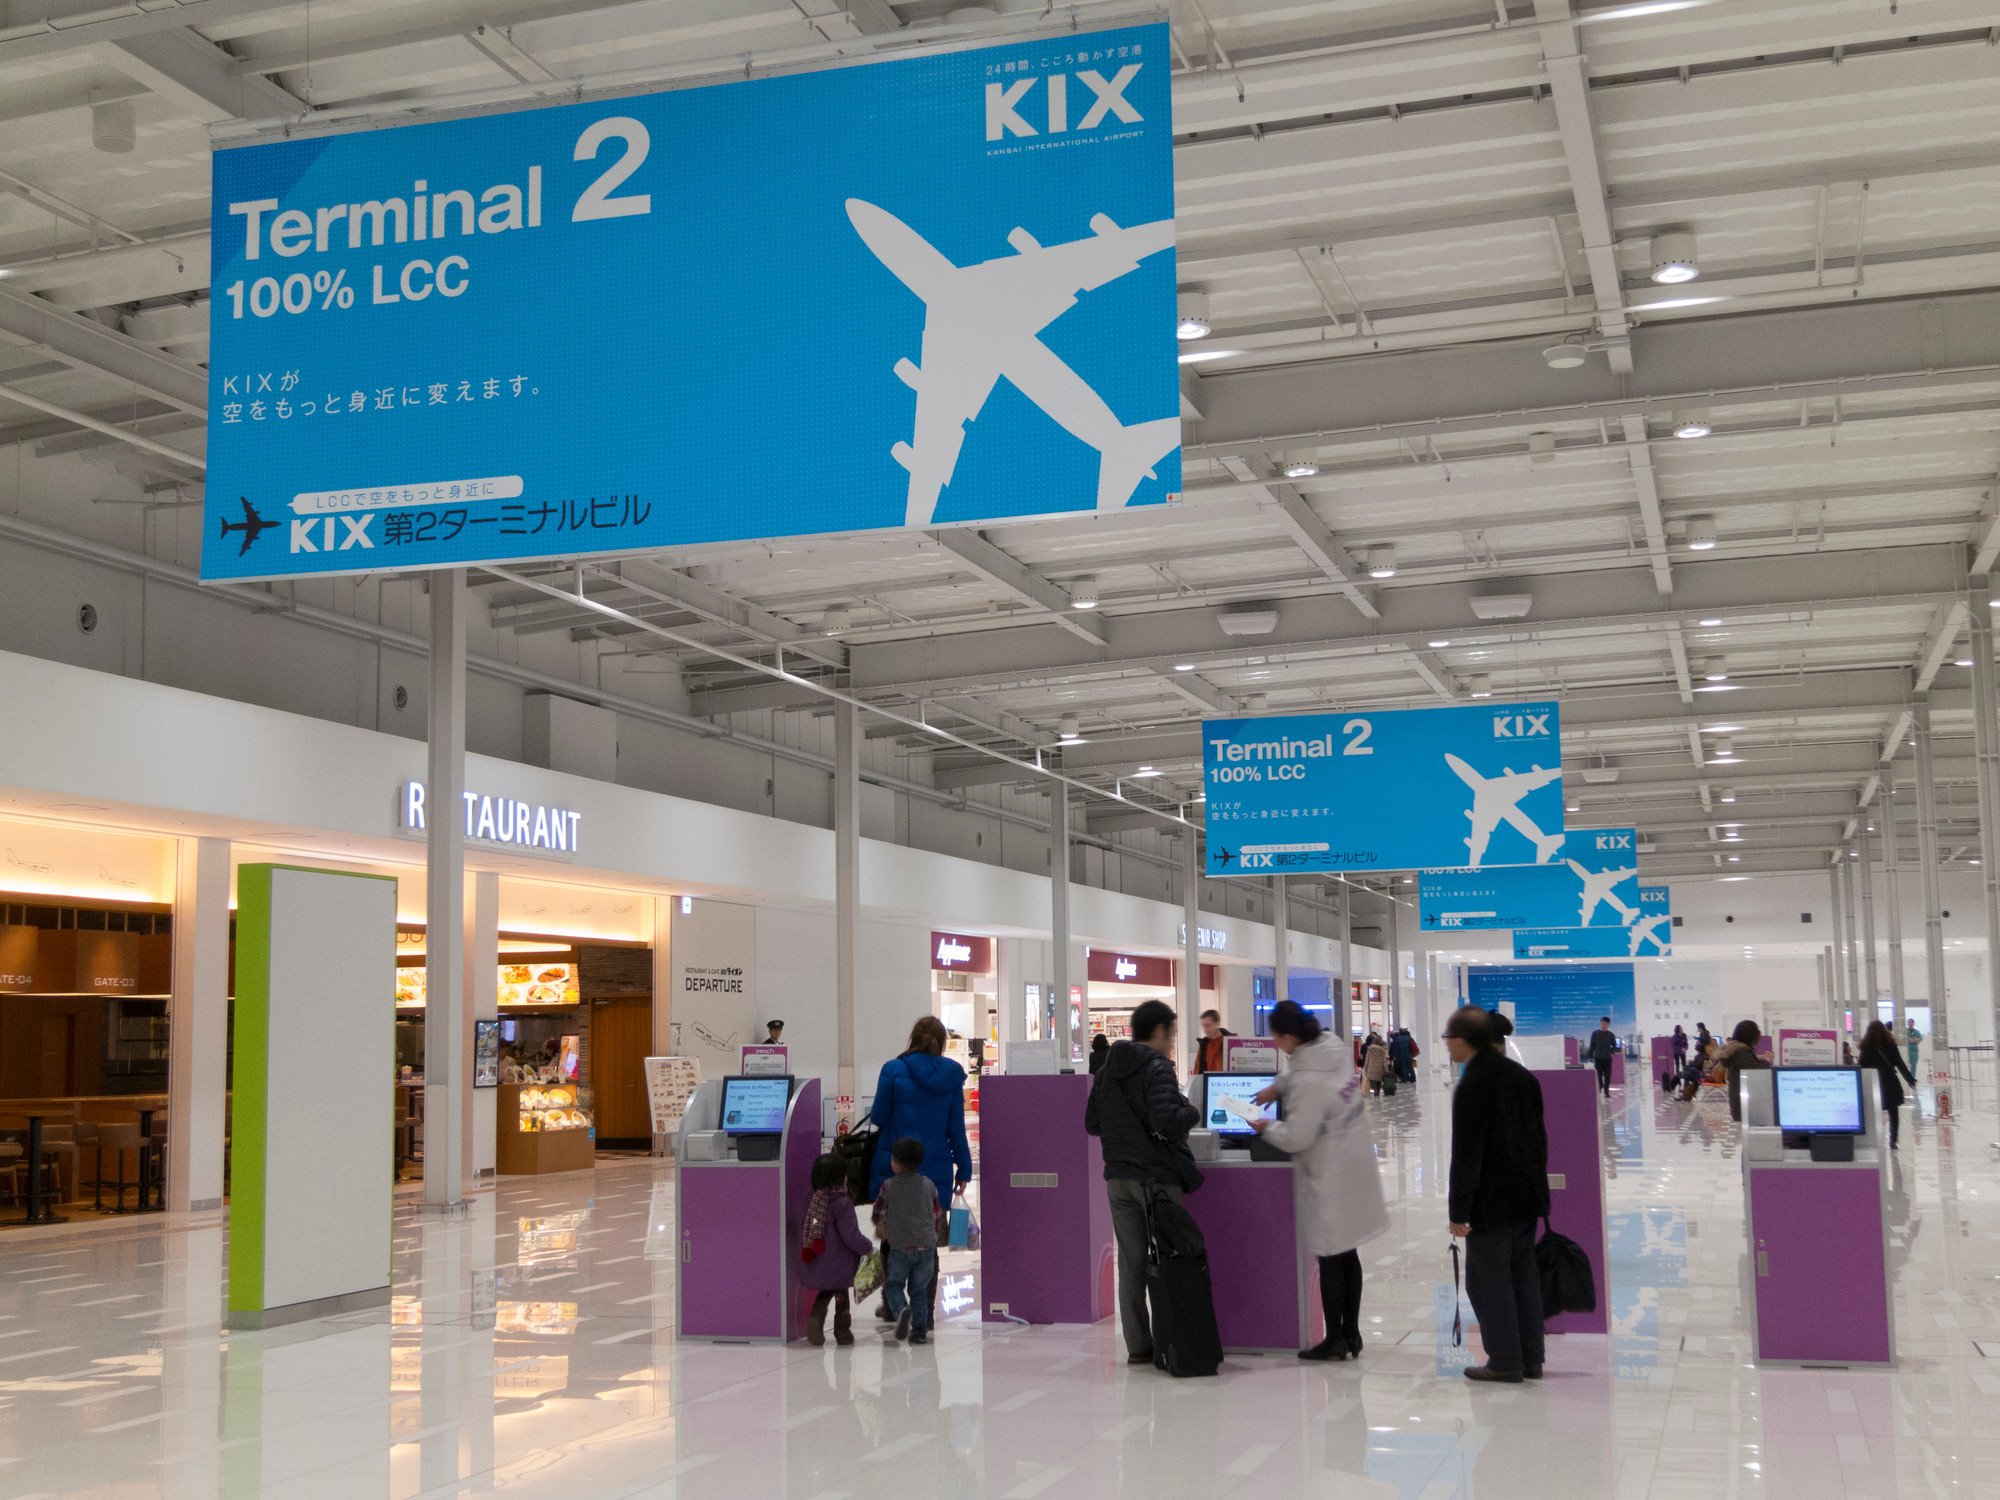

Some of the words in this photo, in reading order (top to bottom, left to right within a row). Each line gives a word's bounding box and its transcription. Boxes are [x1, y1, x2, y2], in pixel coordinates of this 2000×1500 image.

[985, 62, 1145, 142] KIX
[986, 147, 1022, 156] KANSAI
[1025, 137, 1100, 151] INTERNATIONAL
[1103, 131, 1145, 141] AIRPORT
[229, 165, 542, 261] Terminal
[571, 116, 651, 223] 2
[226, 268, 355, 319] 100%
[372, 255, 470, 305] LCC
[223, 369, 301, 396] KIXが
[222, 374, 540, 424] 空をもっと身近に変えます。
[315, 481, 495, 509] LCCで空をもっと身近に
[290, 513, 376, 554] KIX
[383, 494, 652, 546] 第2ターミナルビル
[1493, 714, 1551, 738] KIX
[1210, 734, 1333, 763] Terminal
[1342, 718, 1374, 756] 2
[1210, 766, 1262, 783] 100%
[1267, 764, 1306, 781] LCC
[408, 781, 582, 852] RTAURANT
[1211, 802, 1242, 810] KIXが
[1595, 835, 1632, 850] KIX
[1240, 854, 1274, 868] KIX
[1276, 851, 1378, 866] 第2ターミナルビル
[1640, 891, 1666, 902] KIX
[1440, 918, 1462, 927] KIX
[94, 977, 135, 987] GATE-03
[685, 977, 743, 993] DEPARTURE
[1796, 1031, 1821, 1039] peach
